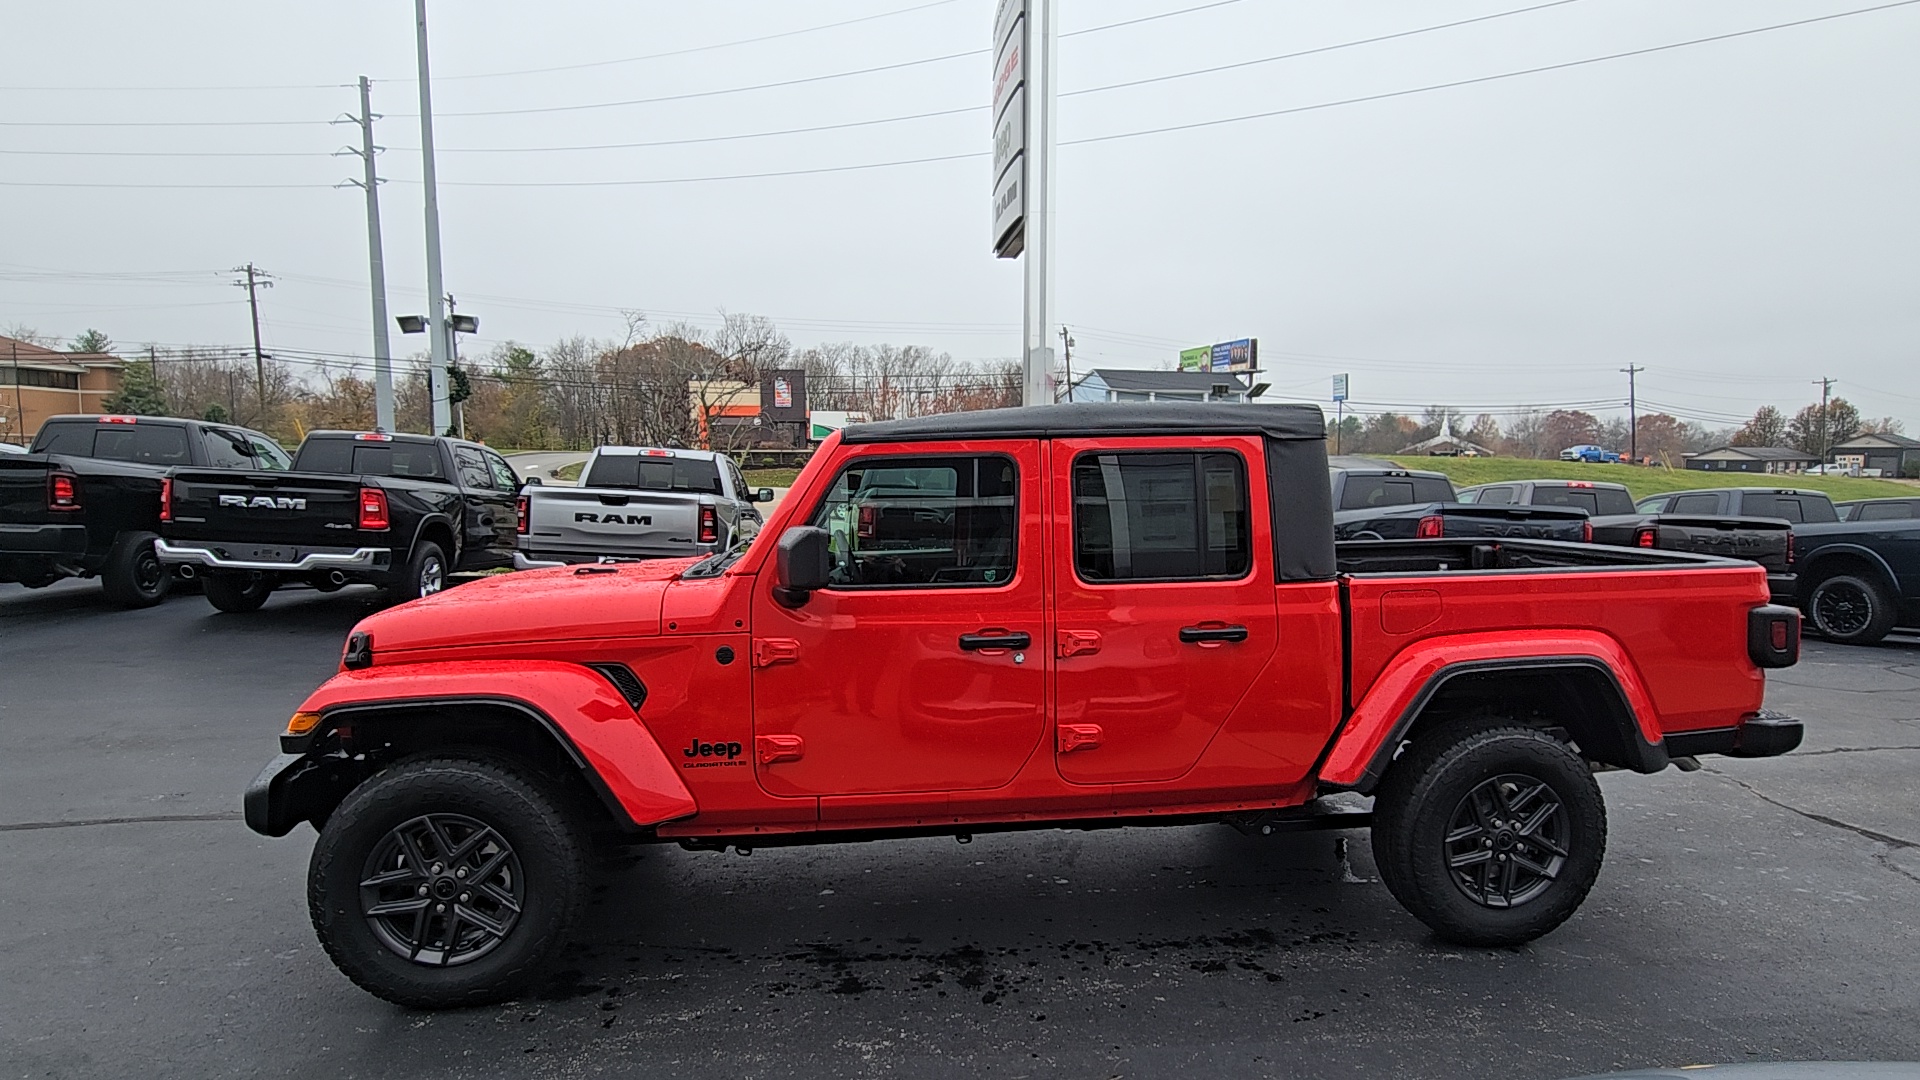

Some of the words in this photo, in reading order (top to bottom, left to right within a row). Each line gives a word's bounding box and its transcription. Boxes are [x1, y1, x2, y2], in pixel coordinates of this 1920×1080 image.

[993, 45, 1018, 117] ODGE
[219, 494, 307, 510] RAM
[574, 512, 653, 526] RAM
[1479, 524, 1555, 538] RAM
[1690, 533, 1760, 548] RAM
[683, 738, 742, 760] Jeep
